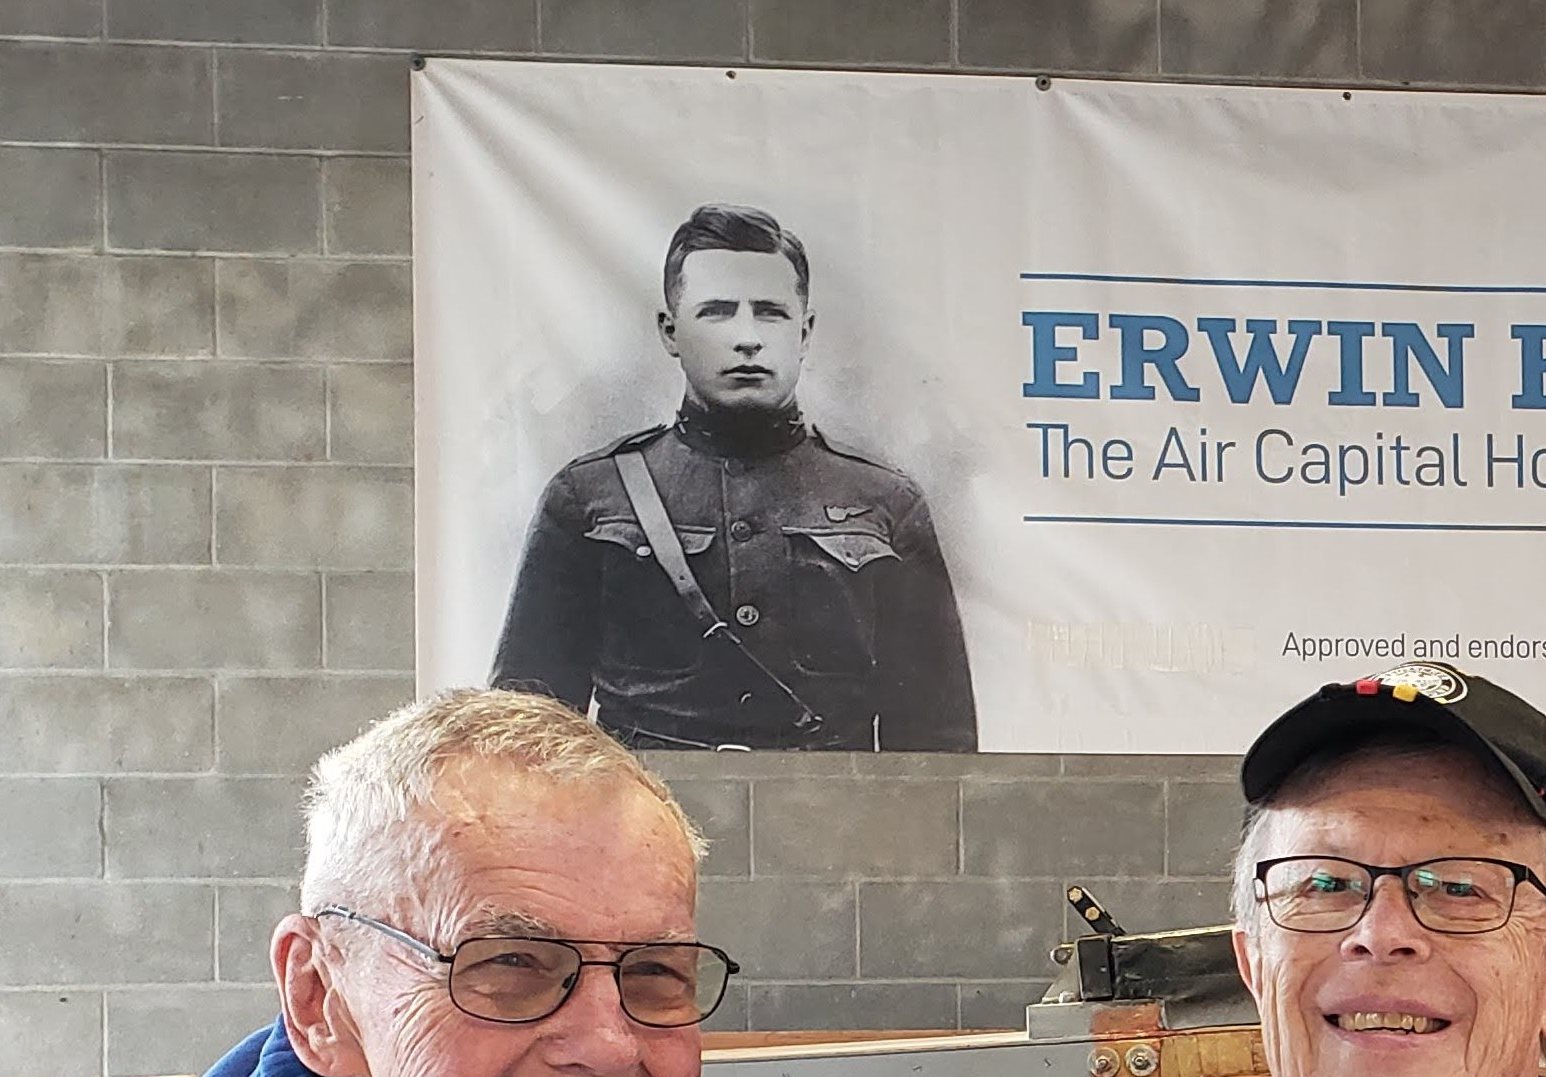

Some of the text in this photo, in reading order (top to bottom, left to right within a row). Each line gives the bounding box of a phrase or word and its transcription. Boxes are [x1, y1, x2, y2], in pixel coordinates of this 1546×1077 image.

[1022, 311, 1475, 408] ERWIN
[1026, 422, 1134, 480] The
[1152, 425, 1236, 482] Air
[1255, 428, 1467, 497] Capital
[1281, 631, 1405, 662] Approved
[1413, 633, 1460, 659] and
